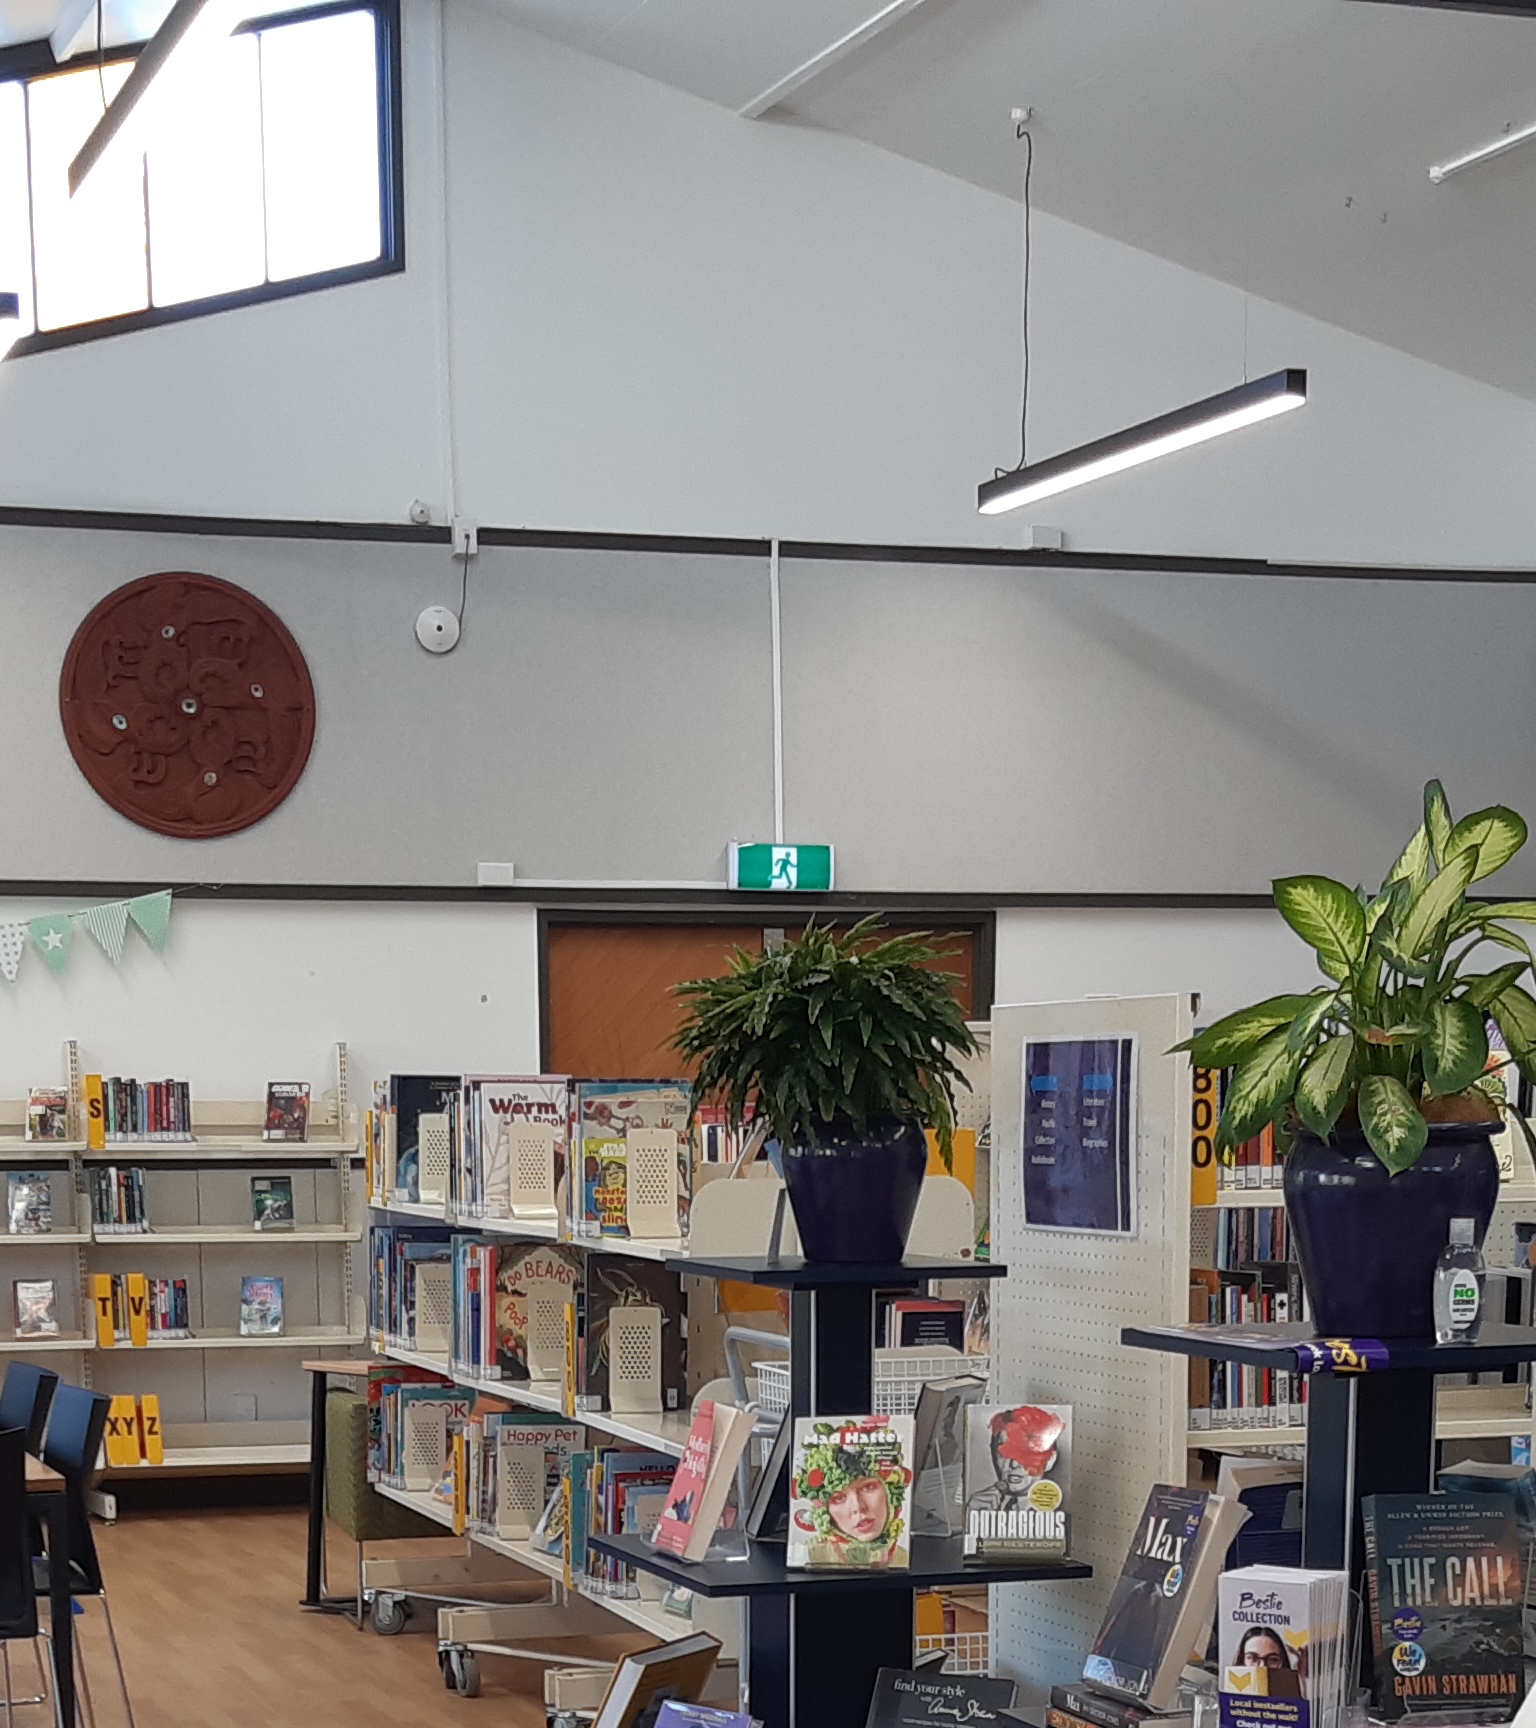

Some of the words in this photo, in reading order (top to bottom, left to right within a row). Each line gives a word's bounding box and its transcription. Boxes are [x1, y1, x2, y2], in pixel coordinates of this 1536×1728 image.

[489, 1097, 559, 1115] Worm
[511, 1092, 529, 1102] The
[88, 1097, 102, 1119] S
[506, 1272, 523, 1287] DO
[523, 1260, 574, 1286] BEARS
[1453, 1287, 1476, 1299] NO
[97, 1297, 111, 1317] T
[130, 1296, 144, 1316] V
[503, 1301, 528, 1331] POOP
[107, 1415, 135, 1437] XY
[146, 1415, 158, 1436] Z
[506, 1428, 553, 1445] Happy
[554, 1428, 579, 1442] Pet
[803, 1432, 841, 1445] Mad
[844, 1431, 903, 1445] Hatter
[969, 1510, 1066, 1539] OUTRAGEOUS
[1135, 1515, 1188, 1564] Max
[1385, 1555, 1440, 1608] THE
[1444, 1555, 1514, 1607] CALL
[1238, 1591, 1283, 1611] Bestie
[1231, 1610, 1291, 1626] COLLECTION
[893, 1678, 916, 1692] find
[915, 1683, 939, 1696] your
[941, 1684, 967, 1700] style
[1393, 1674, 1438, 1698] GAVIN
[1441, 1672, 1518, 1697] STRAWHAN
[1229, 1698, 1252, 1709] Local
[1253, 1700, 1298, 1713] bestsellers
[1229, 1708, 1261, 1719] without
[1263, 1710, 1276, 1720] the
